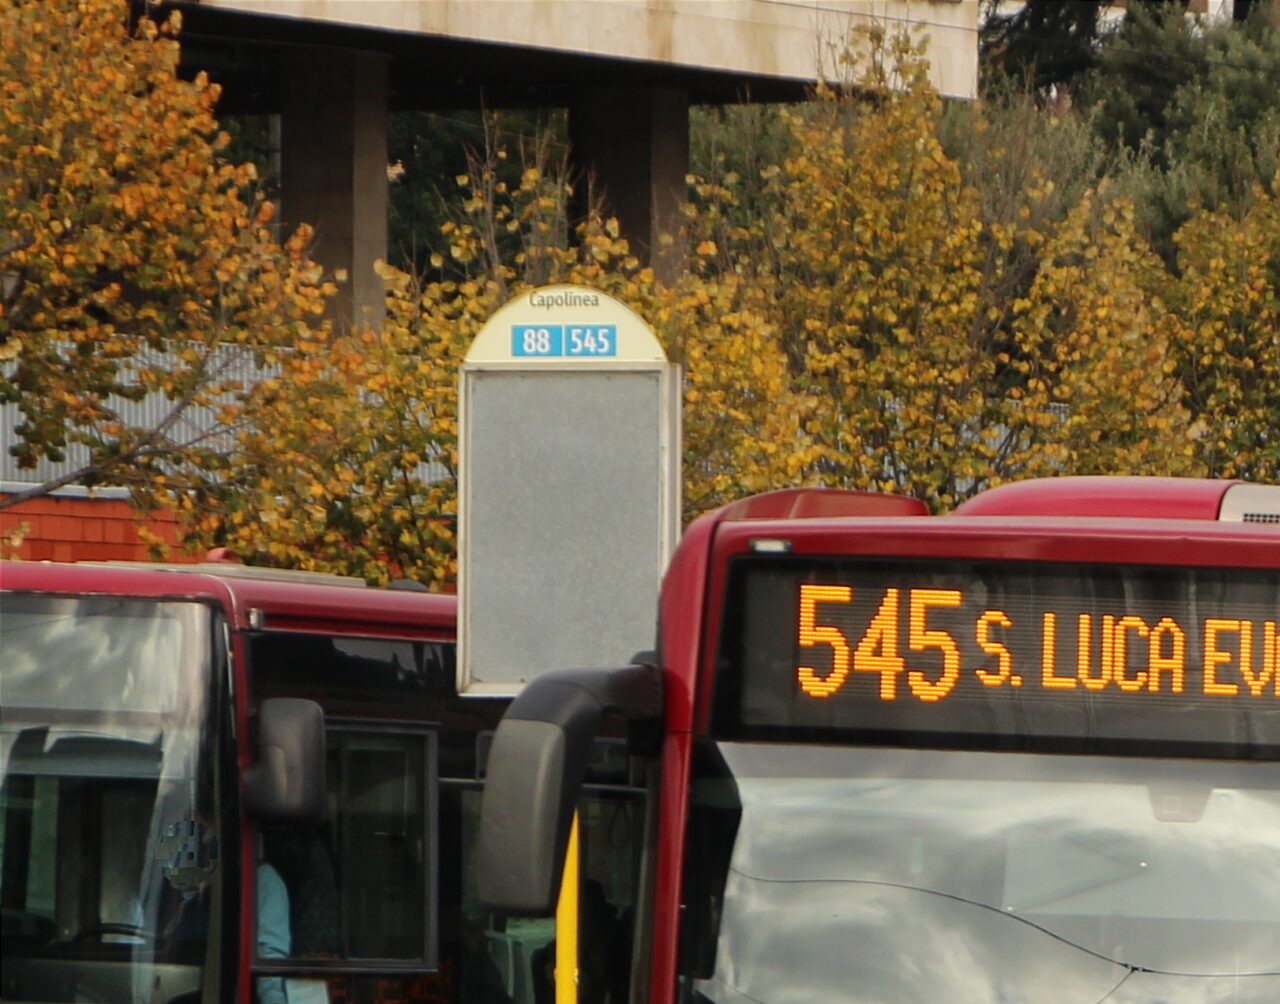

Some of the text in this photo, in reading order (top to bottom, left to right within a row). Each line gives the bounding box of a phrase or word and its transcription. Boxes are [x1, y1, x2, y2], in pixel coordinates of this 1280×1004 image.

[529, 290, 600, 310] Capolinea
[523, 328, 610, 353] 88 545
[798, 584, 963, 702] 545
[975, 610, 1023, 686] S.
[1042, 611, 1185, 694] LUCA
